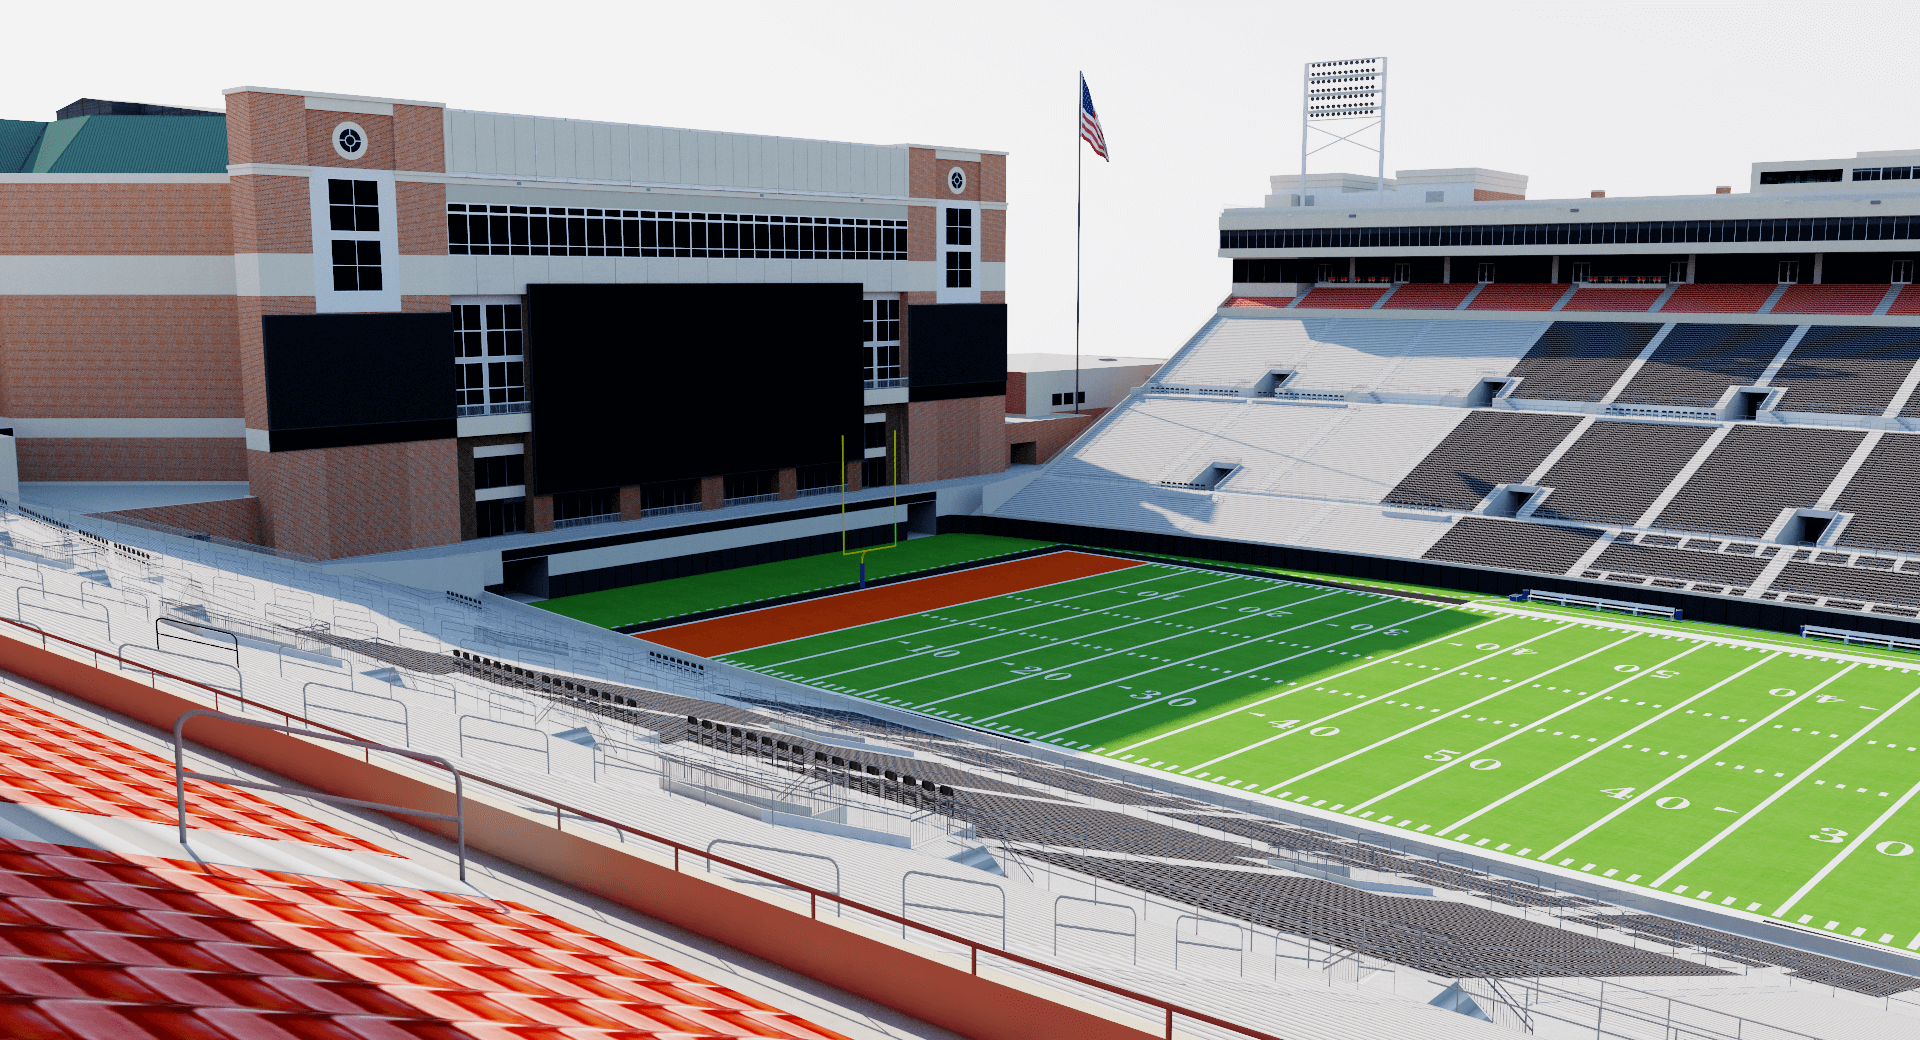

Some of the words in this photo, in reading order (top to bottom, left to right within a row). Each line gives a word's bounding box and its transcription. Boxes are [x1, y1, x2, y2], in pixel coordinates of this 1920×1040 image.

[1137, 590, 1185, 601] 10
[1239, 607, 1293, 618] 20
[1350, 624, 1409, 637] 30
[906, 645, 960, 658] 10
[1475, 643, 1538, 656] 40
[1009, 666, 1072, 681] 20
[1614, 665, 1680, 680] 50
[1130, 690, 1197, 707] 30
[1769, 688, 1845, 704] 40
[1268, 720, 1340, 737] 40
[1424, 749, 1501, 771] 50
[1600, 787, 1690, 810] 40
[1809, 828, 1914, 857] 30
